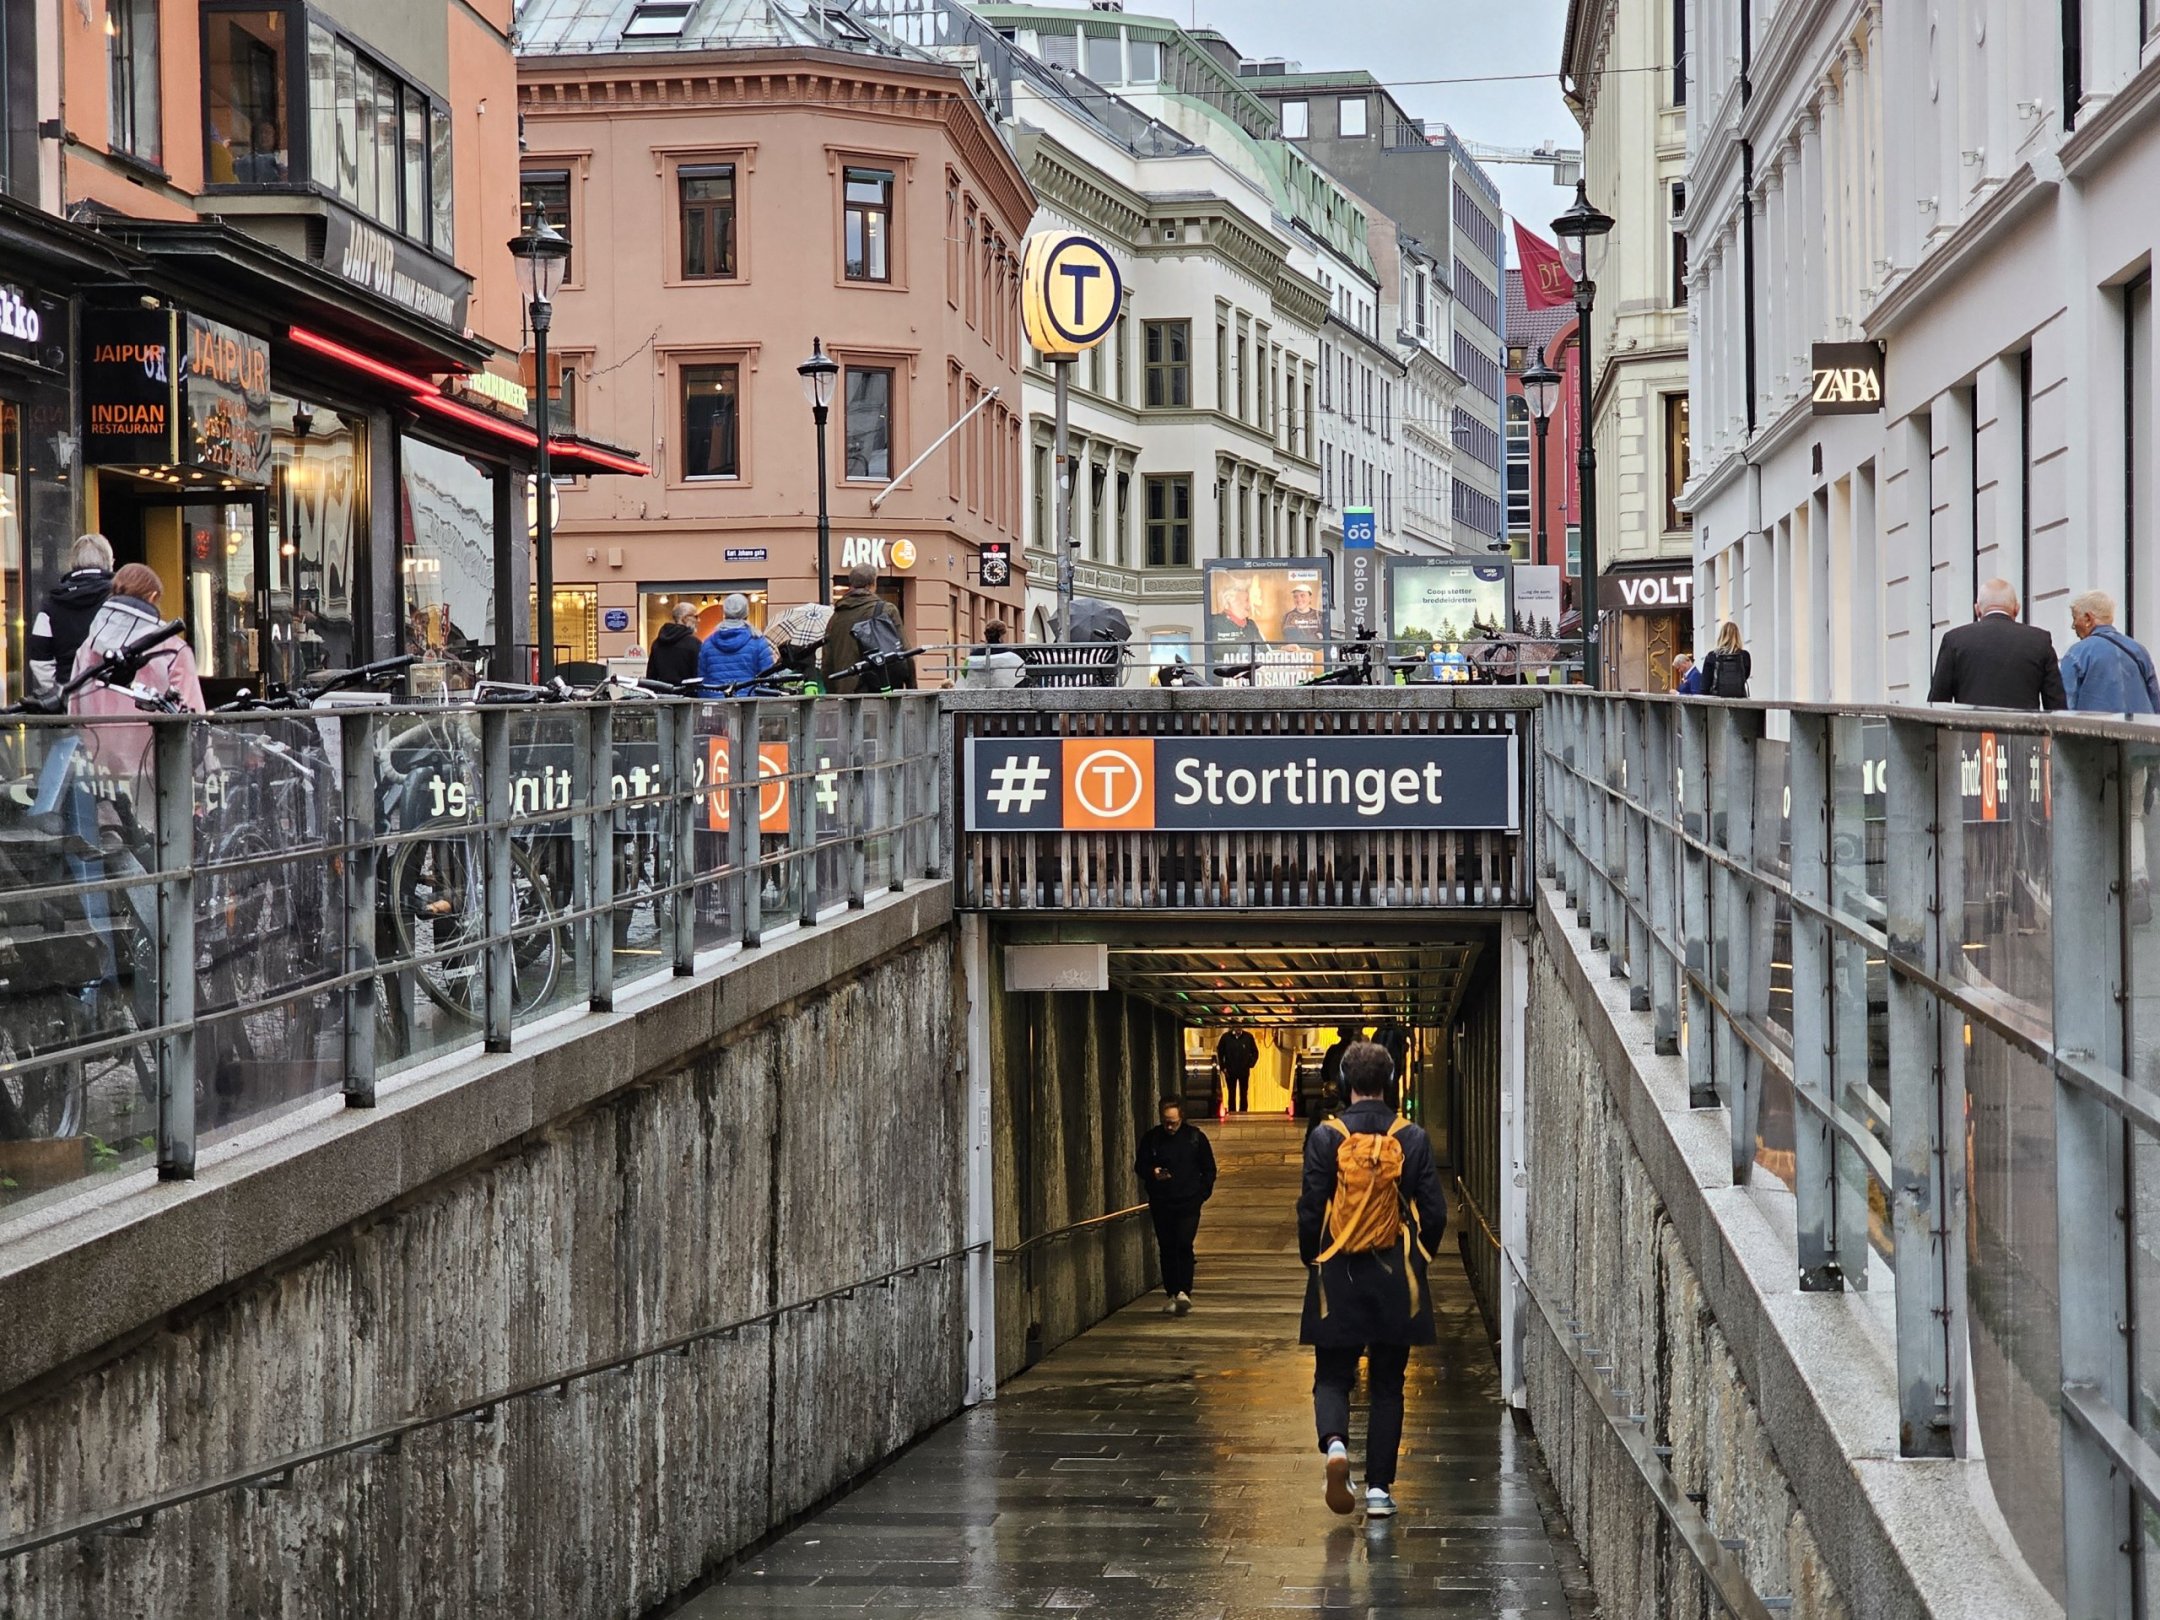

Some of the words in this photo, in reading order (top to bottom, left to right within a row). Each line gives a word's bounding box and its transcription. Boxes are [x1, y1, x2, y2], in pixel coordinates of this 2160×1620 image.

[343, 219, 395, 297] JAIPUR
[392, 270, 416, 307] INDIAN
[414, 282, 455, 326] RESTAURANT
[93, 344, 161, 363] JAIPUR
[192, 327, 267, 396] JAIPUR
[1812, 367, 1880, 403] ZARA
[91, 404, 164, 424] INDIAN
[91, 424, 165, 435] RESTAURANT
[841, 536, 887, 569] ARK
[1354, 556, 1368, 592] Oslo
[1618, 576, 1692, 605] VOLT
[1174, 757, 1443, 816] Stortinget
